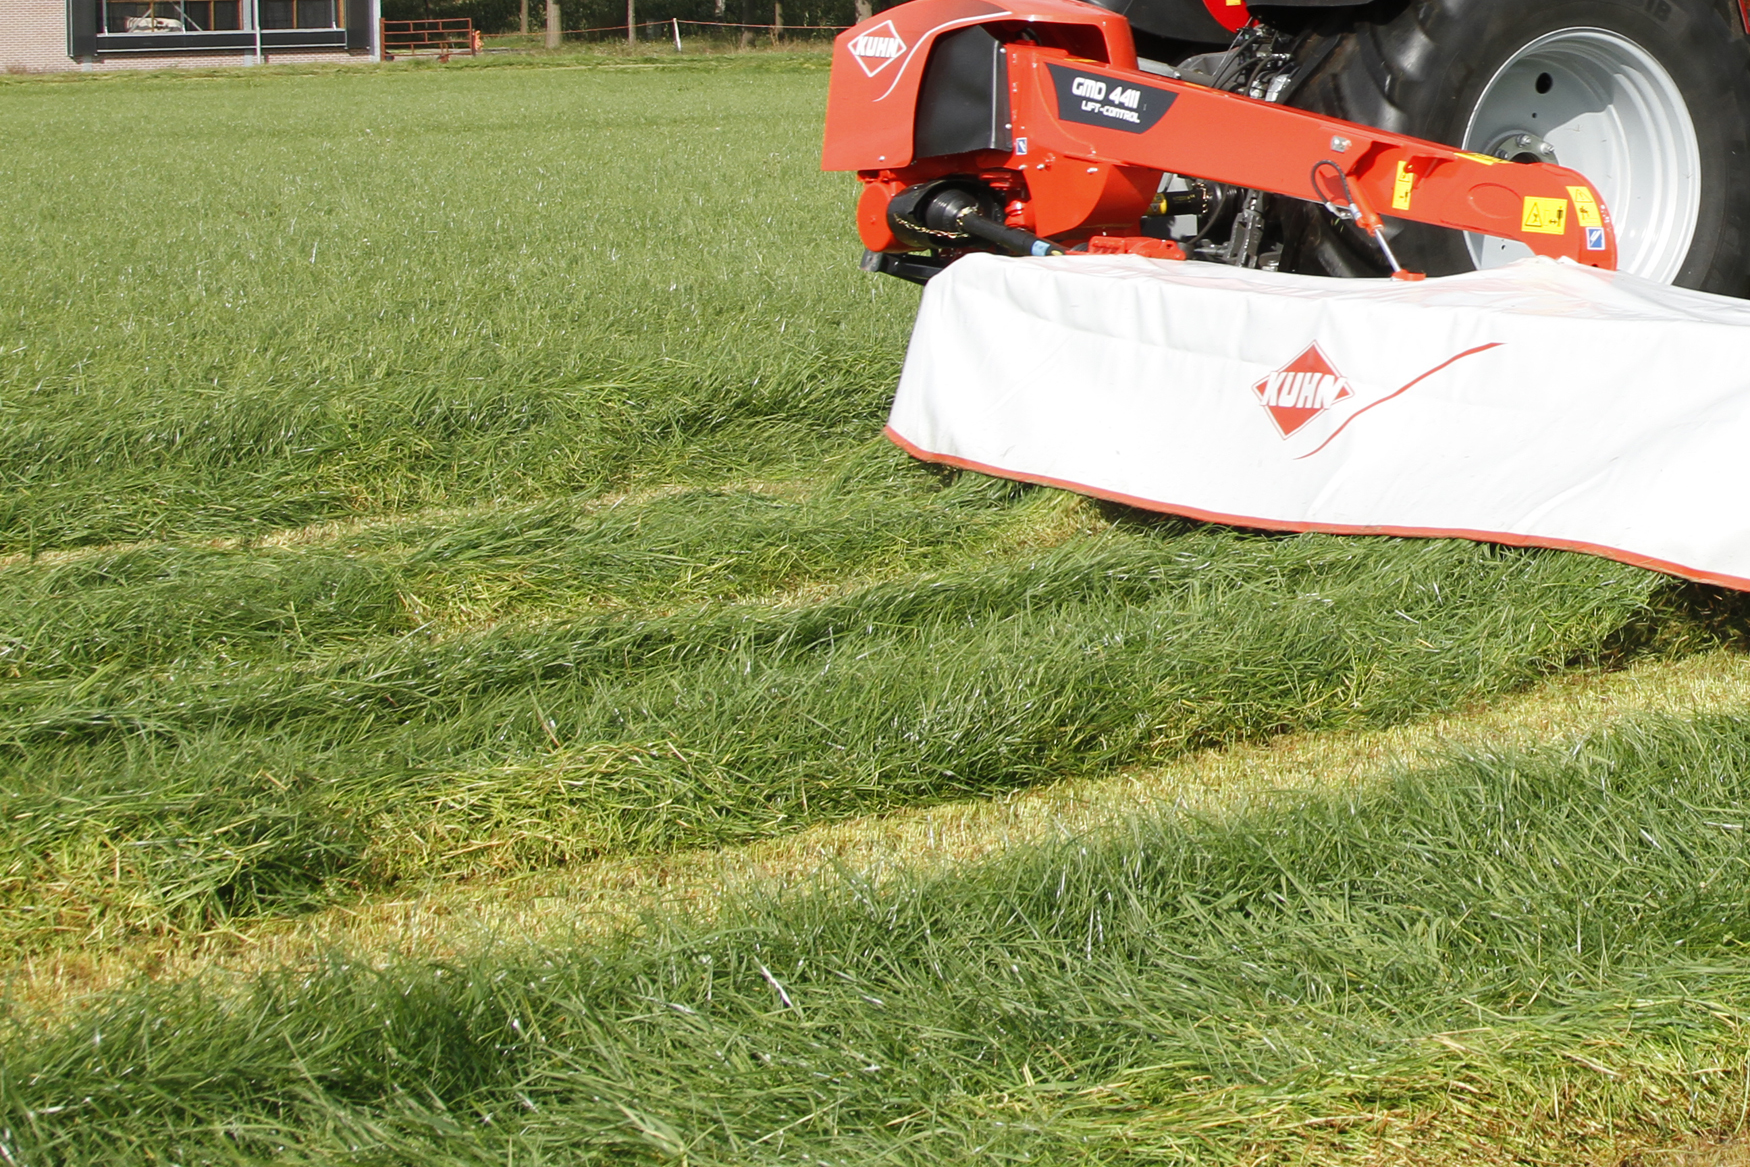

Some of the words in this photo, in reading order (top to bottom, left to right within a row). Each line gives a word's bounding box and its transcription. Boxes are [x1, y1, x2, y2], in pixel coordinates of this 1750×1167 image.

[855, 36, 899, 58] KUHN
[1072, 77, 1106, 101] GMD
[1108, 86, 1141, 109] 4411
[1081, 100, 1141, 124] LIFT-CONTROL
[1260, 371, 1348, 410] KUHN
